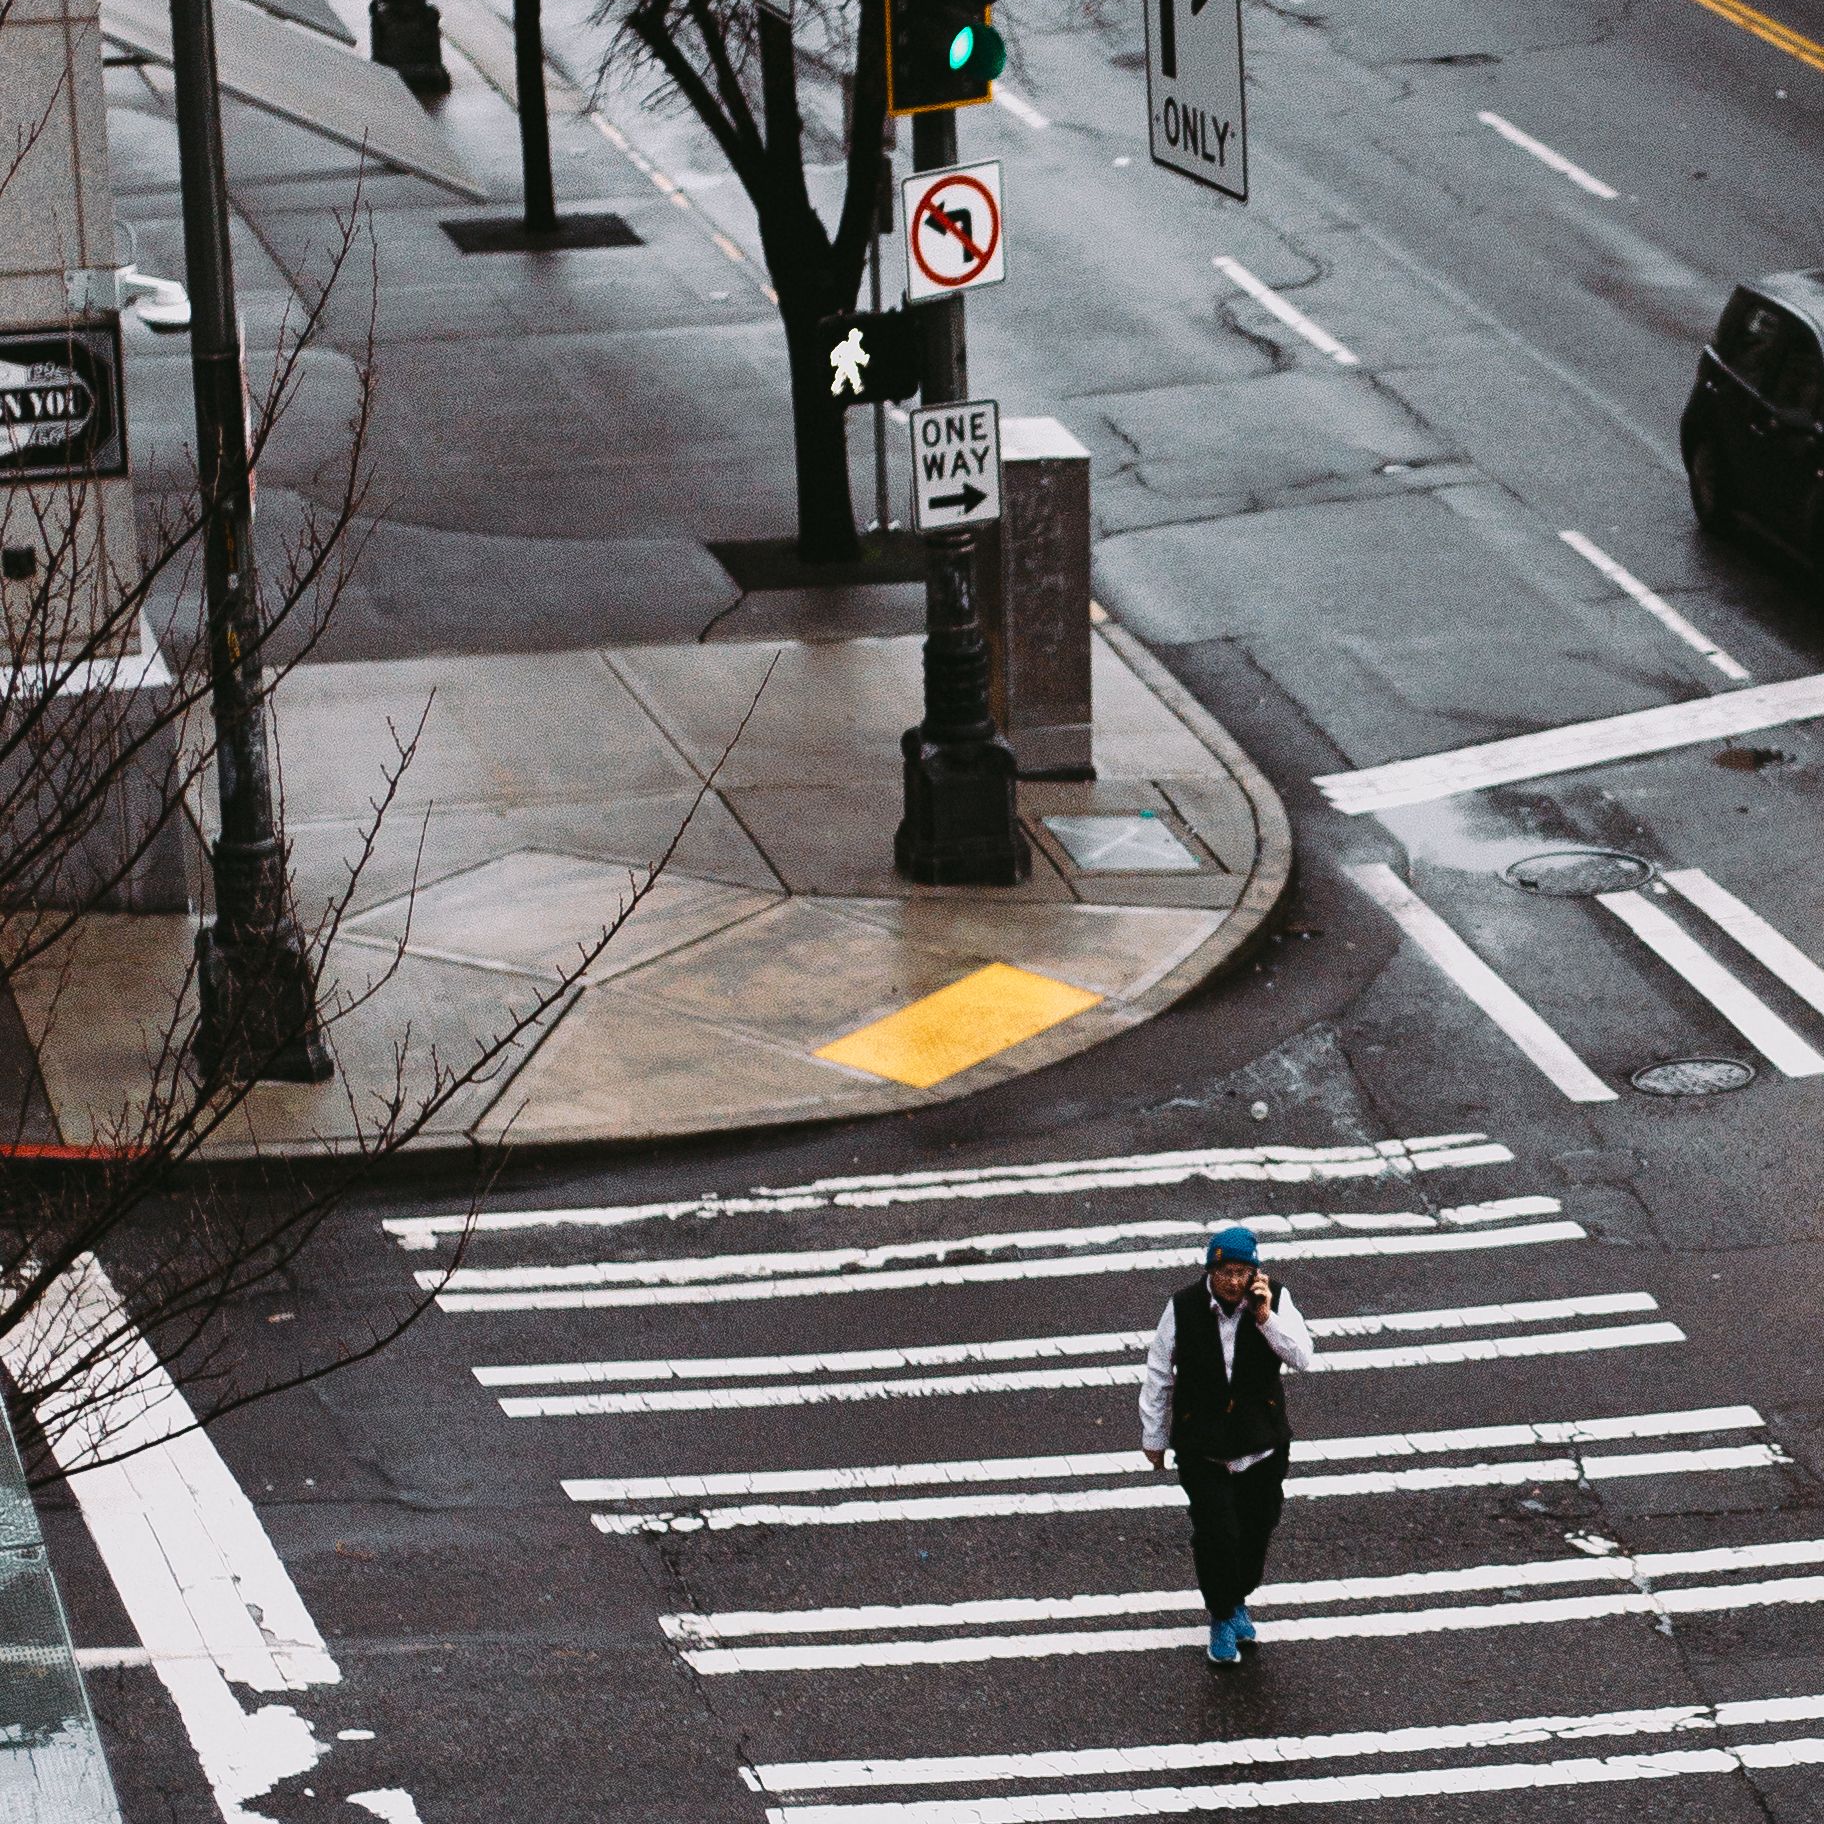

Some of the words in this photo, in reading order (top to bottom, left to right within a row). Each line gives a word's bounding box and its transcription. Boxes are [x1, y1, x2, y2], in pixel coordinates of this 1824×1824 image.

[1163, 96, 1230, 167] ONLY
[922, 411, 989, 448] ONE
[922, 445, 991, 482] WAY
